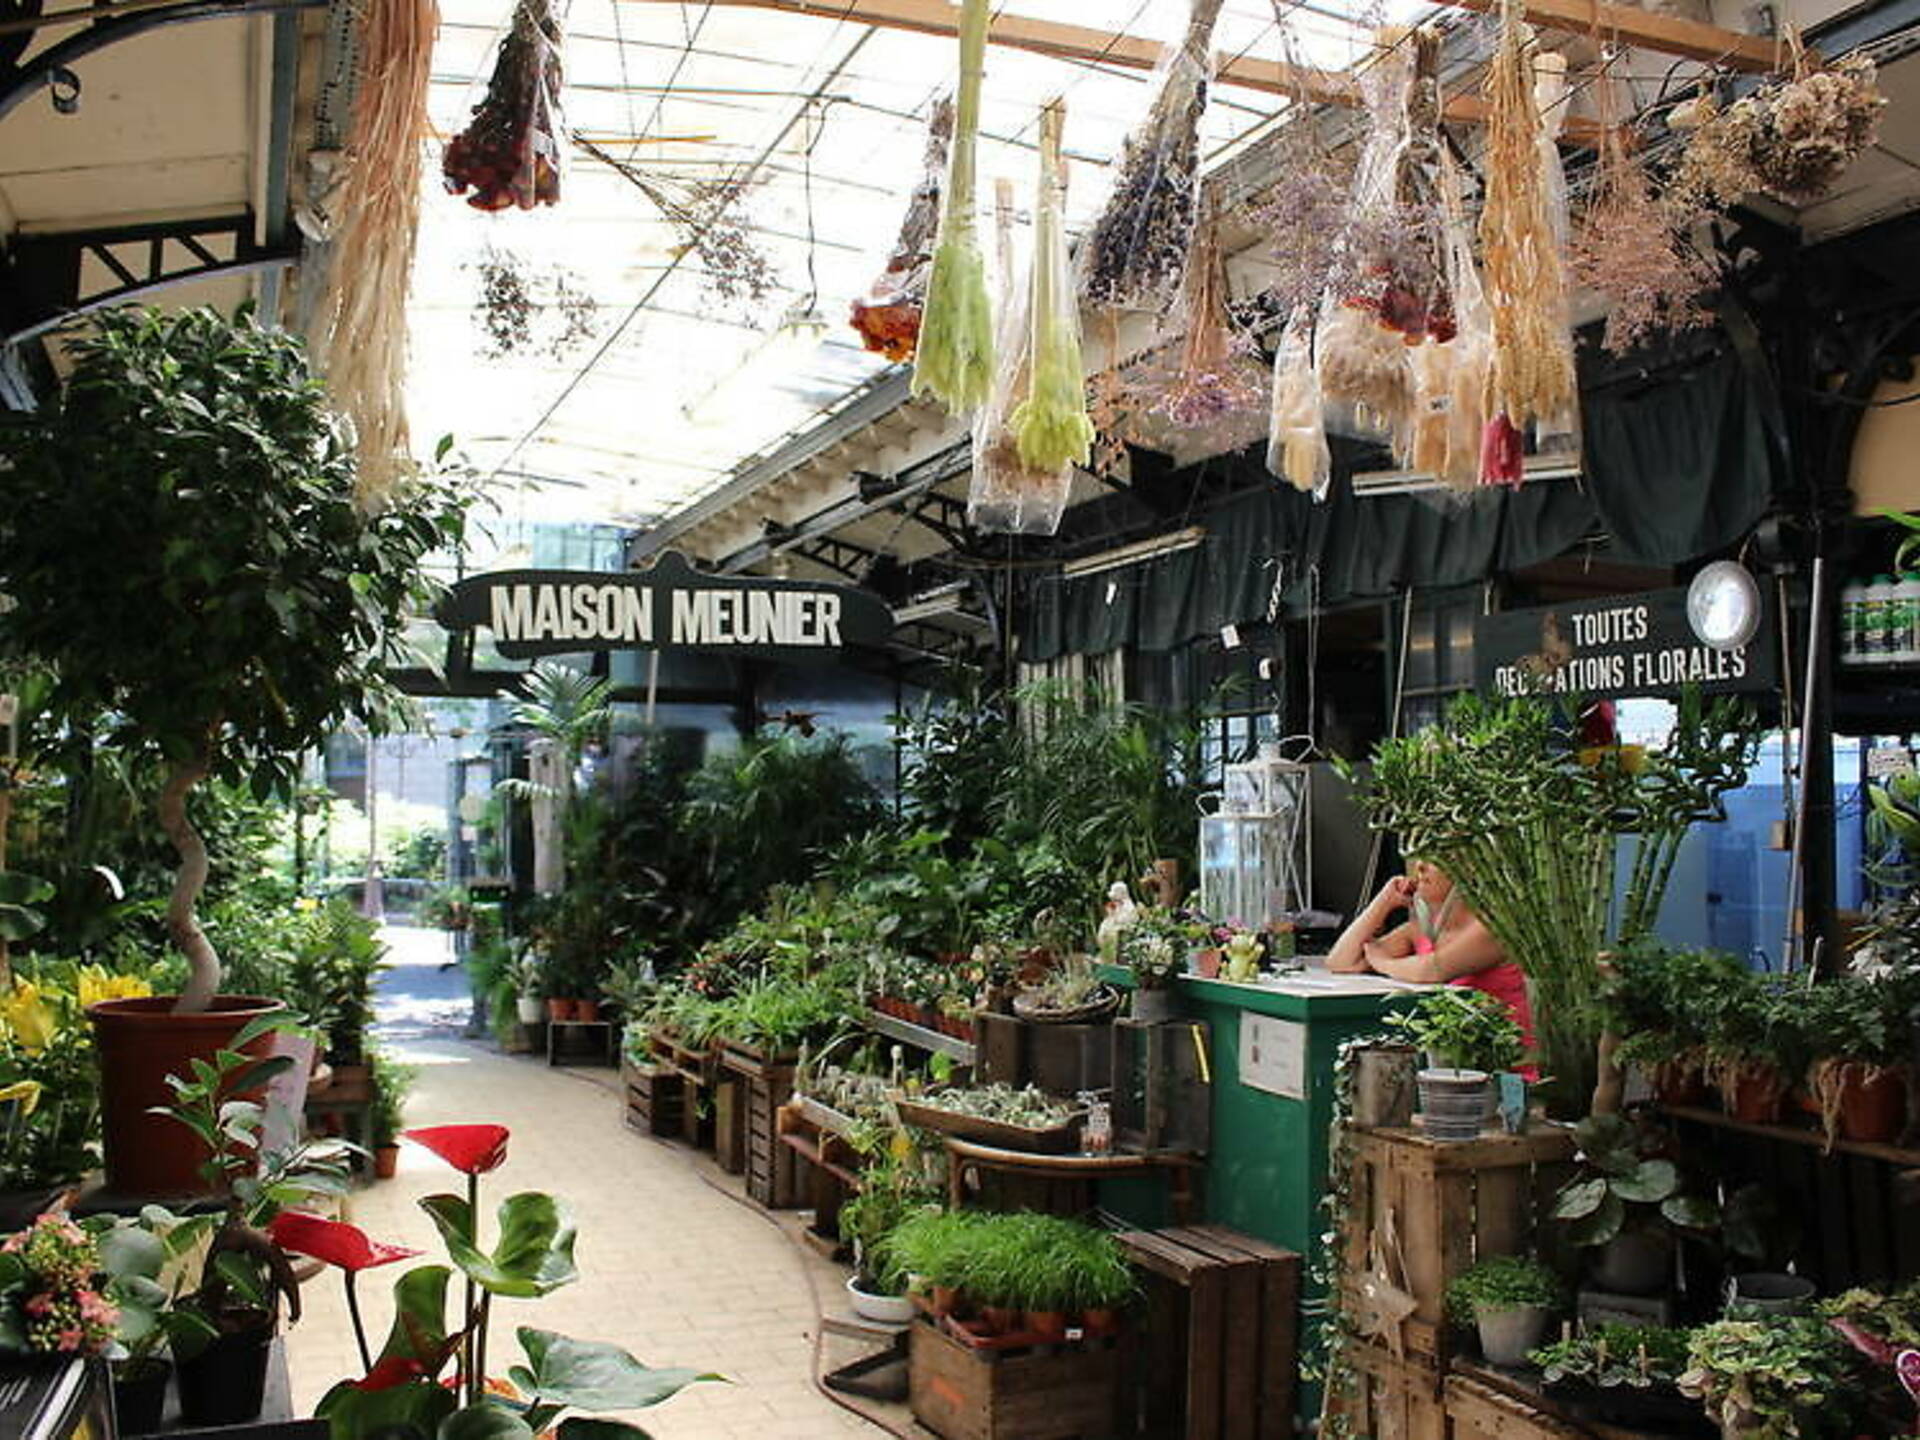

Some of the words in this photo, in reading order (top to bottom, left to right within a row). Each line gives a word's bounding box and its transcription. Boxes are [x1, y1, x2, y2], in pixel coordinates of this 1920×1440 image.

[491, 584, 653, 641] MAISON
[672, 589, 842, 647] MEUNIER
[1572, 606, 1648, 646] TOUTES
[1494, 655, 1625, 697] DECATIONS
[1633, 647, 1746, 687] FLORALES
